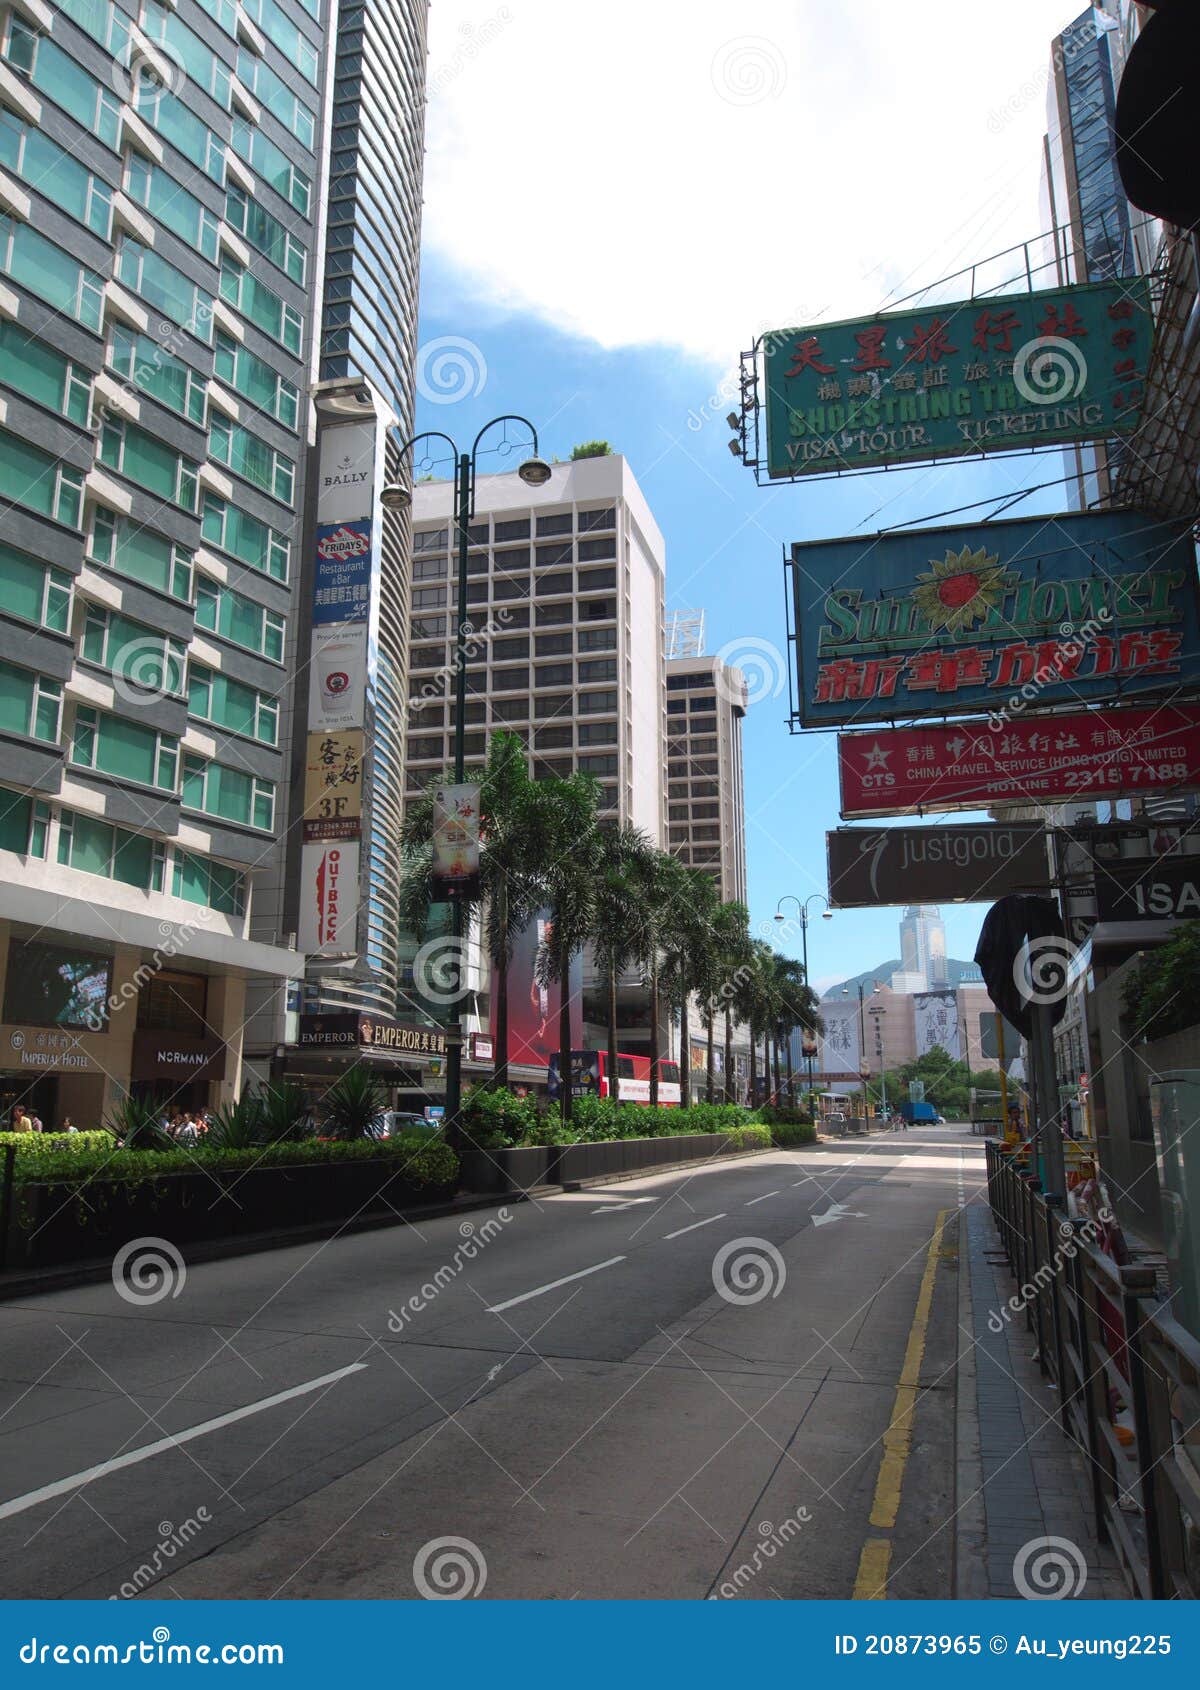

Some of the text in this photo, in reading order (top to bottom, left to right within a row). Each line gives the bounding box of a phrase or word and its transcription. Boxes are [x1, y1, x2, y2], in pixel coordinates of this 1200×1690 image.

[784, 303, 1089, 378] 天星旅行社
[789, 386, 971, 437] SHOESTRING
[785, 437, 840, 462] VISA
[957, 404, 1103, 440] TICKETING
[324, 472, 368, 486] BALLY
[320, 561, 365, 575] Restaurant
[337, 574, 351, 585] Bar
[906, 745, 936, 762] 香港
[1090, 726, 1155, 747] 有限公司
[906, 768, 943, 780] CHINA
[945, 763, 991, 776] TRAVEL
[994, 758, 1046, 772] SERVICE
[1138, 746, 1187, 761] LIMITED
[986, 779, 1049, 793] HOTLINE
[1064, 768, 1123, 787] 2315
[1128, 763, 1188, 782] 7188
[862, 773, 896, 787] CTS
[318, 796, 348, 818] 3F
[901, 831, 1014, 870] justgold
[326, 849, 341, 942] OUTBACK
[302, 1032, 355, 1043] EMPEROR
[375, 1025, 421, 1050] EMPEROR
